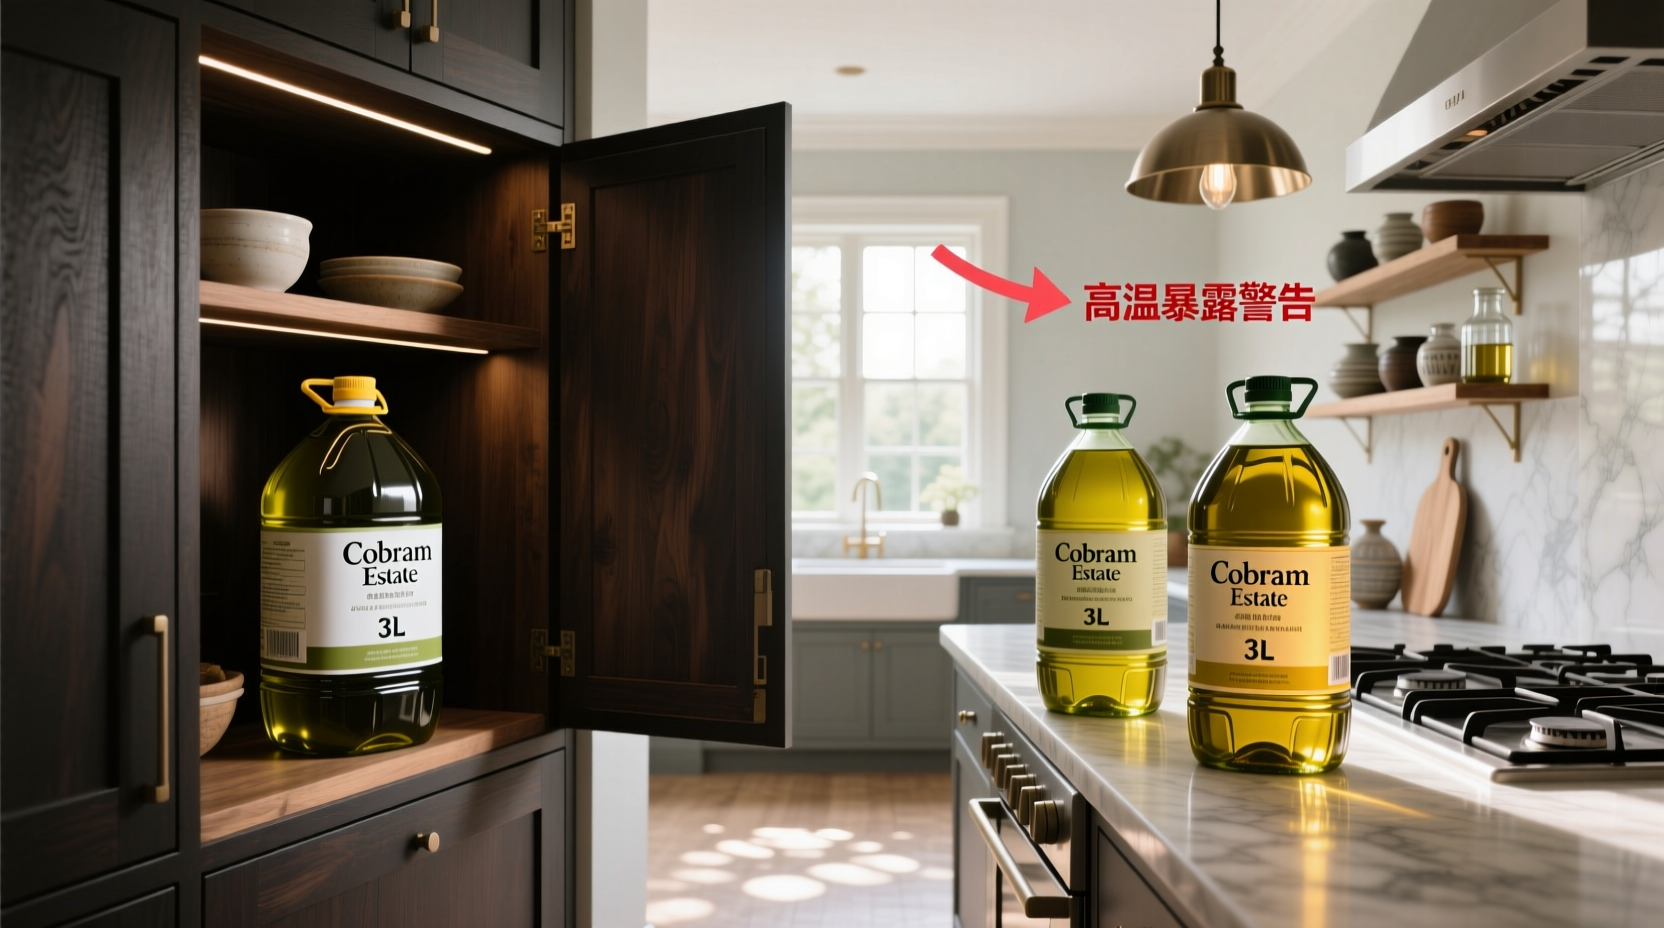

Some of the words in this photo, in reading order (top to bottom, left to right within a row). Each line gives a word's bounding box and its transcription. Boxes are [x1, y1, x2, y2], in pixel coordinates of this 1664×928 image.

[343, 540, 432, 565] Cobram
[1055, 542, 1137, 563] Cobram
[362, 566, 418, 586] Estate
[1072, 564, 1121, 581] Estate
[1210, 560, 1310, 586] Cobram
[1230, 587, 1288, 607] Estate
[378, 615, 405, 638] 3L
[1083, 607, 1109, 626] 3L
[1244, 638, 1274, 661] 3L
